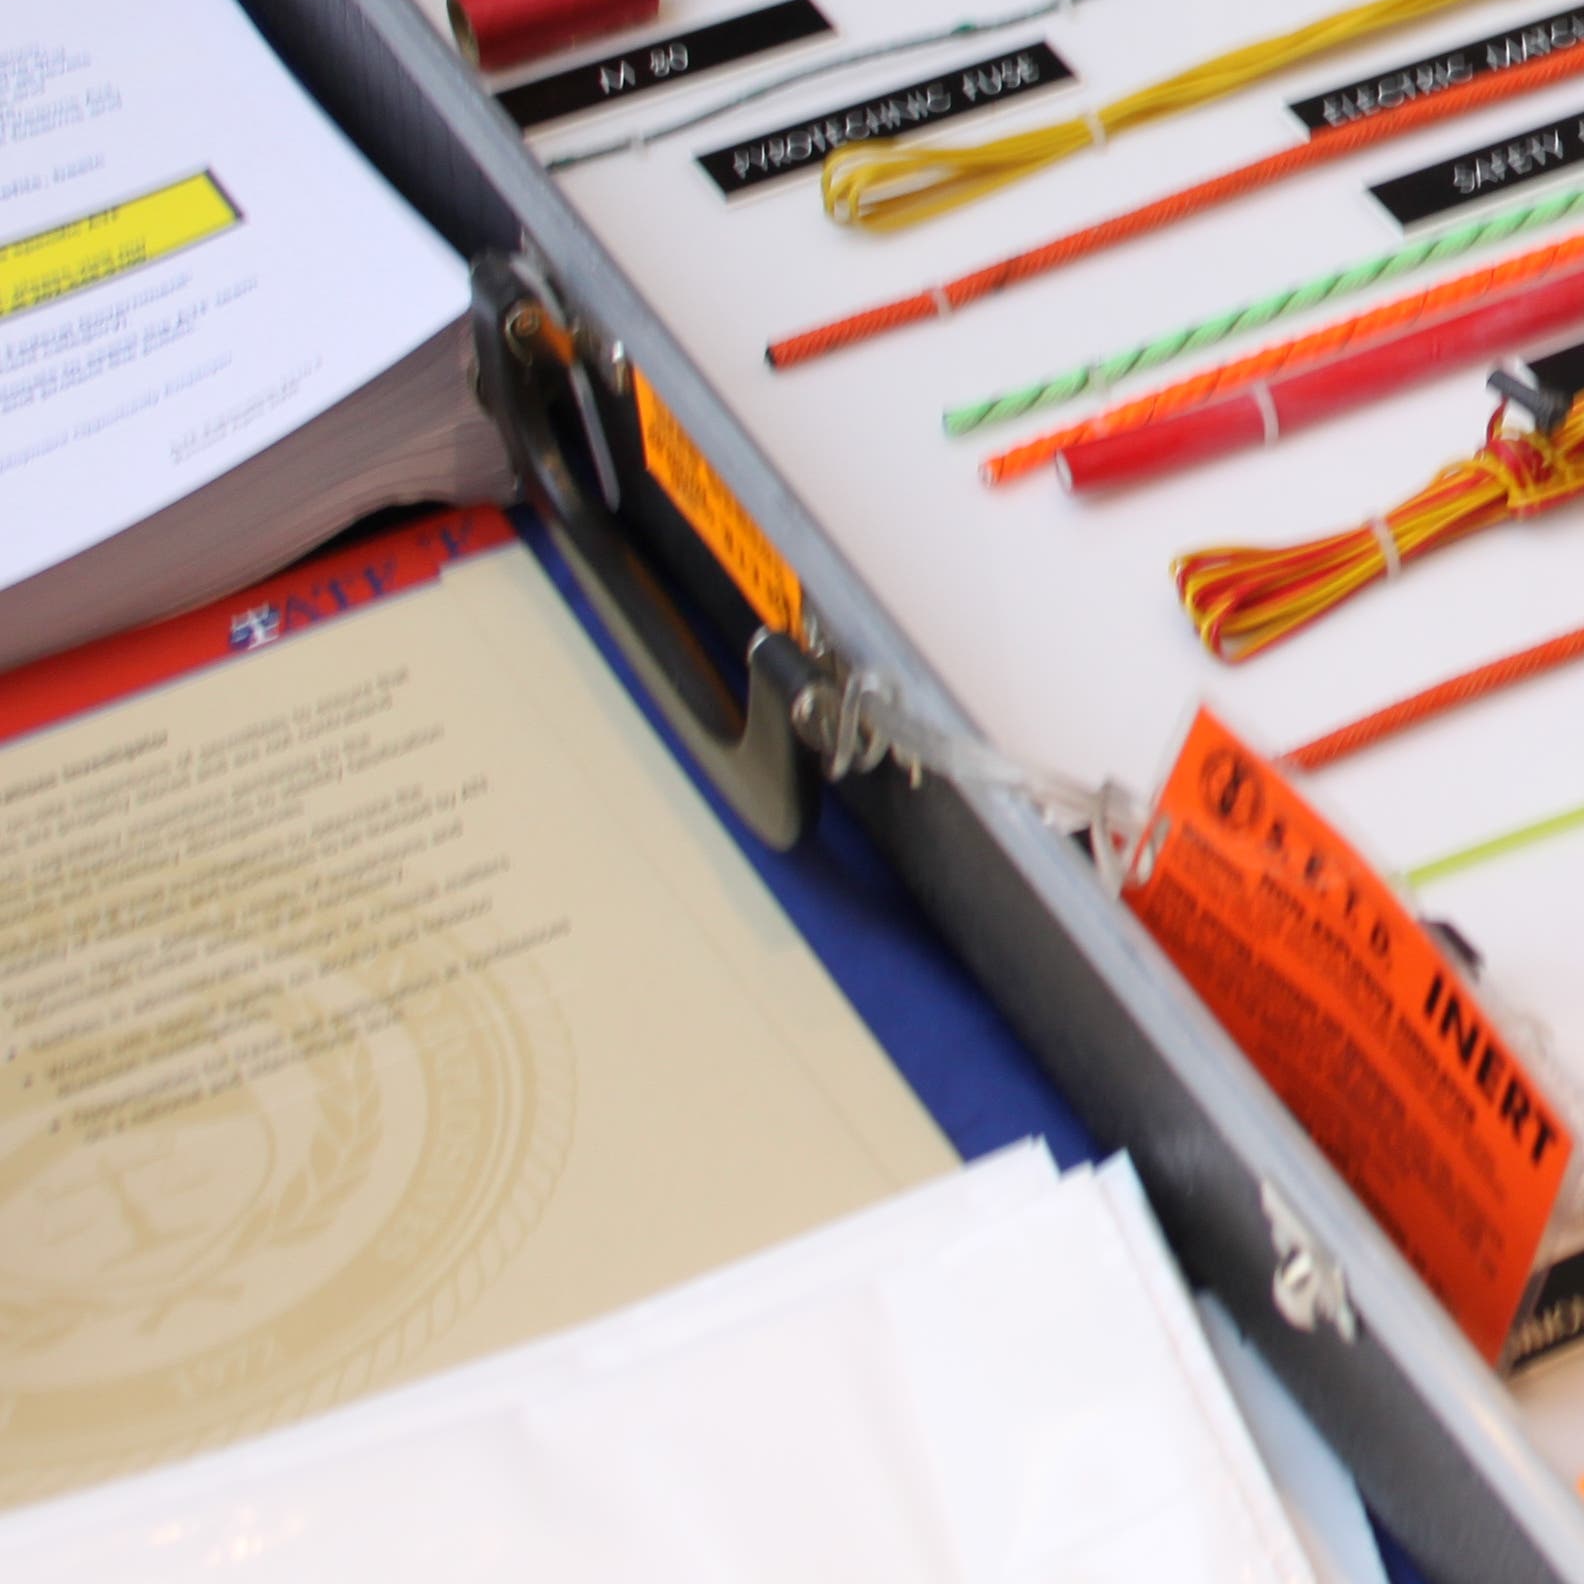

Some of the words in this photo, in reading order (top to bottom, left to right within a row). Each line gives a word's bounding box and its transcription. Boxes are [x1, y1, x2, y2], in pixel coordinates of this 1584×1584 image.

[599, 57, 637, 96] M
[649, 41, 690, 79] 80
[961, 49, 1040, 103] FUSE
[1322, 51, 1473, 129] ELECTRIC
[1452, 127, 1564, 196] SAFETY
[1423, 970, 1558, 1168] INERT
